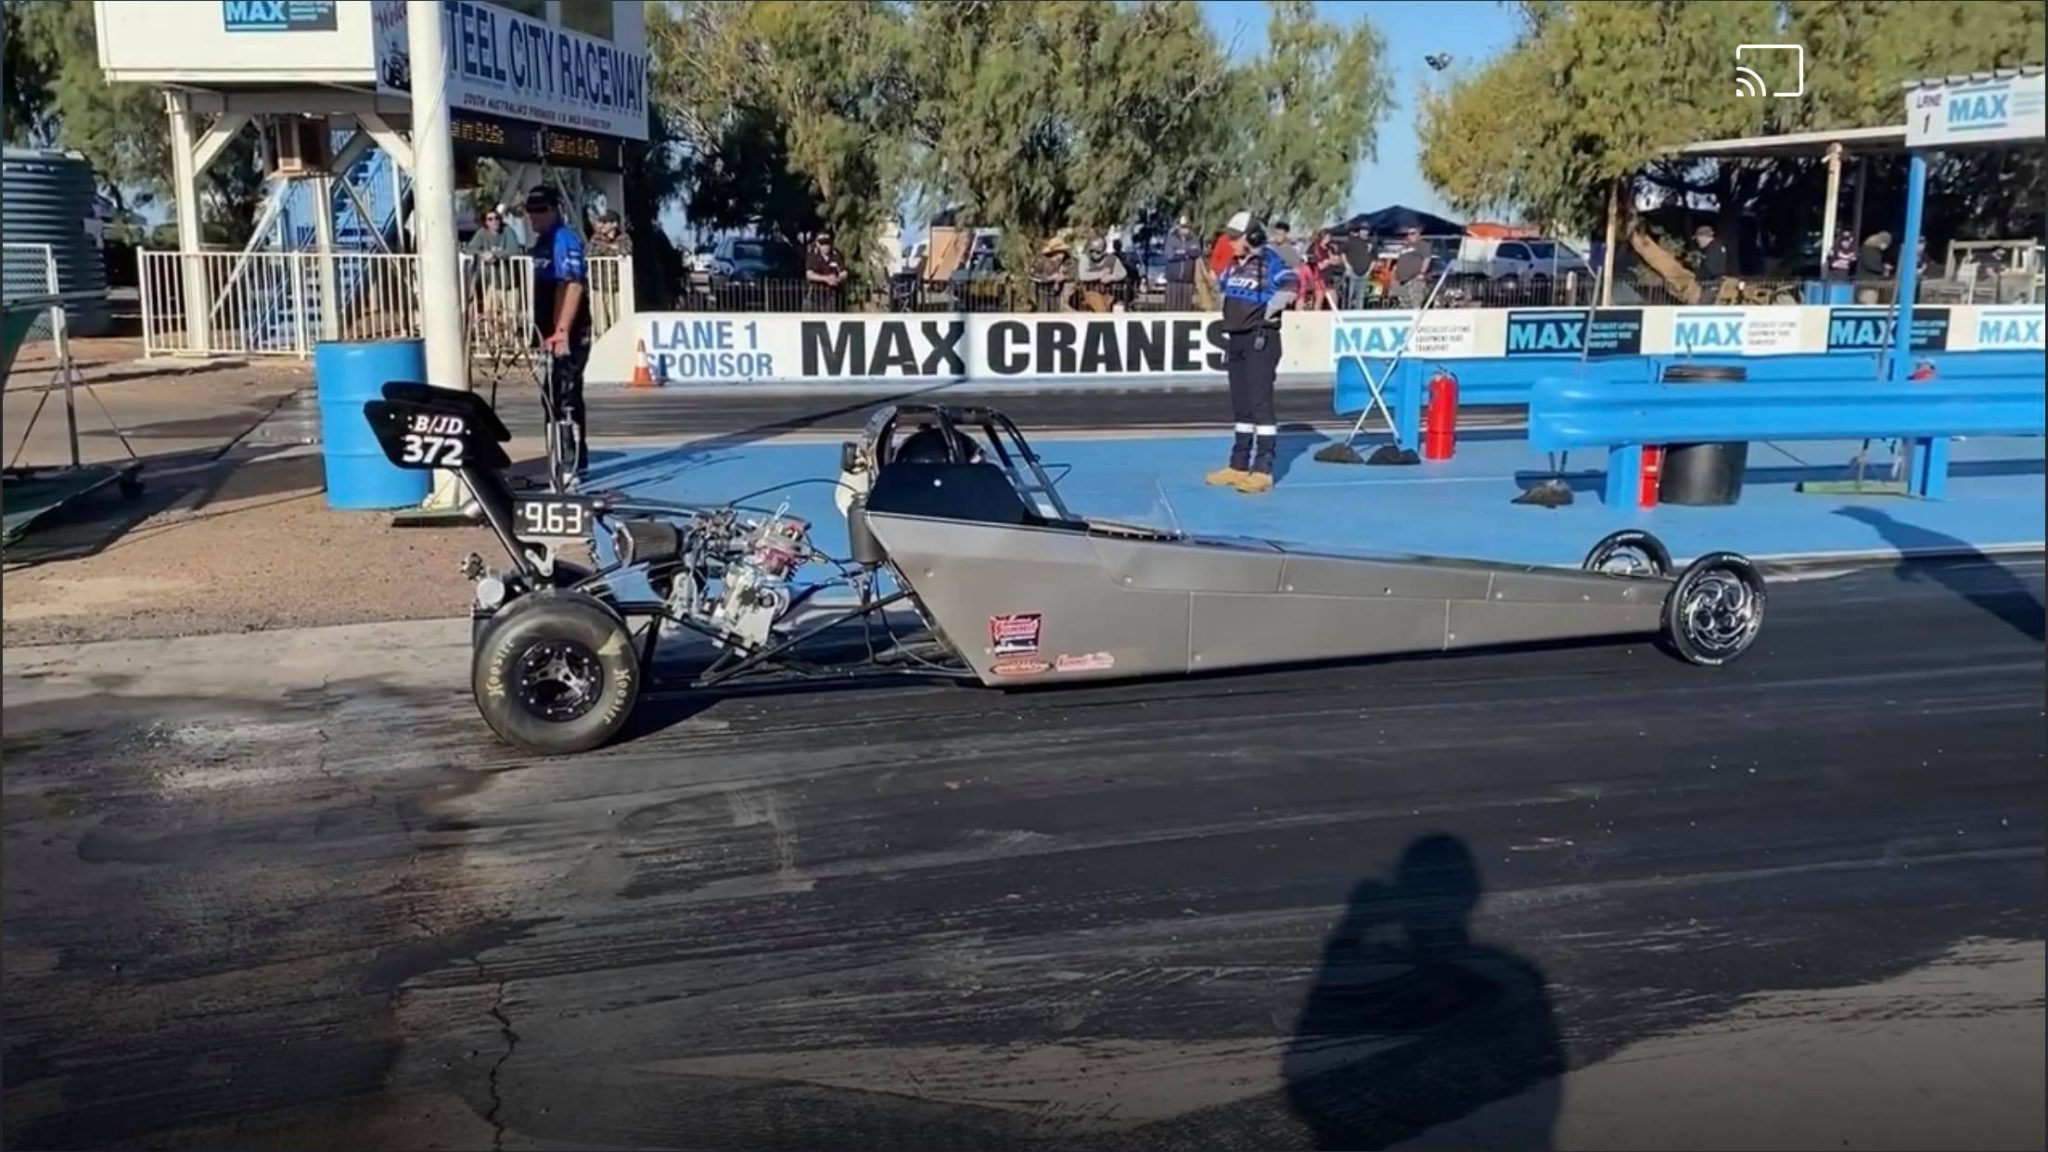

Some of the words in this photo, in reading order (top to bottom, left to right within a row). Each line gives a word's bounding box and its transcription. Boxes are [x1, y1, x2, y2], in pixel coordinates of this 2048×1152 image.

[226, 1, 287, 21] MAX
[445, 1, 506, 82] TEEL
[509, 18, 554, 92] CITY
[559, 34, 644, 110] RACEWAY
[1916, 94, 1942, 108] LANE
[1948, 95, 2008, 122] MAX
[652, 320, 734, 349] LANE
[744, 321, 757, 349] 1
[1334, 326, 1411, 352] MAX
[1509, 322, 1584, 350] MAX
[1675, 322, 1742, 346] MAX
[1831, 320, 1896, 345] MAX
[1978, 320, 2042, 344] MAX
[801, 321, 965, 376] MAX
[986, 320, 1229, 375] CRANES
[646, 352, 774, 377] SPONSOR
[413, 414, 464, 435] B/JD
[402, 434, 464, 467] 372
[524, 502, 582, 534] 9.63
